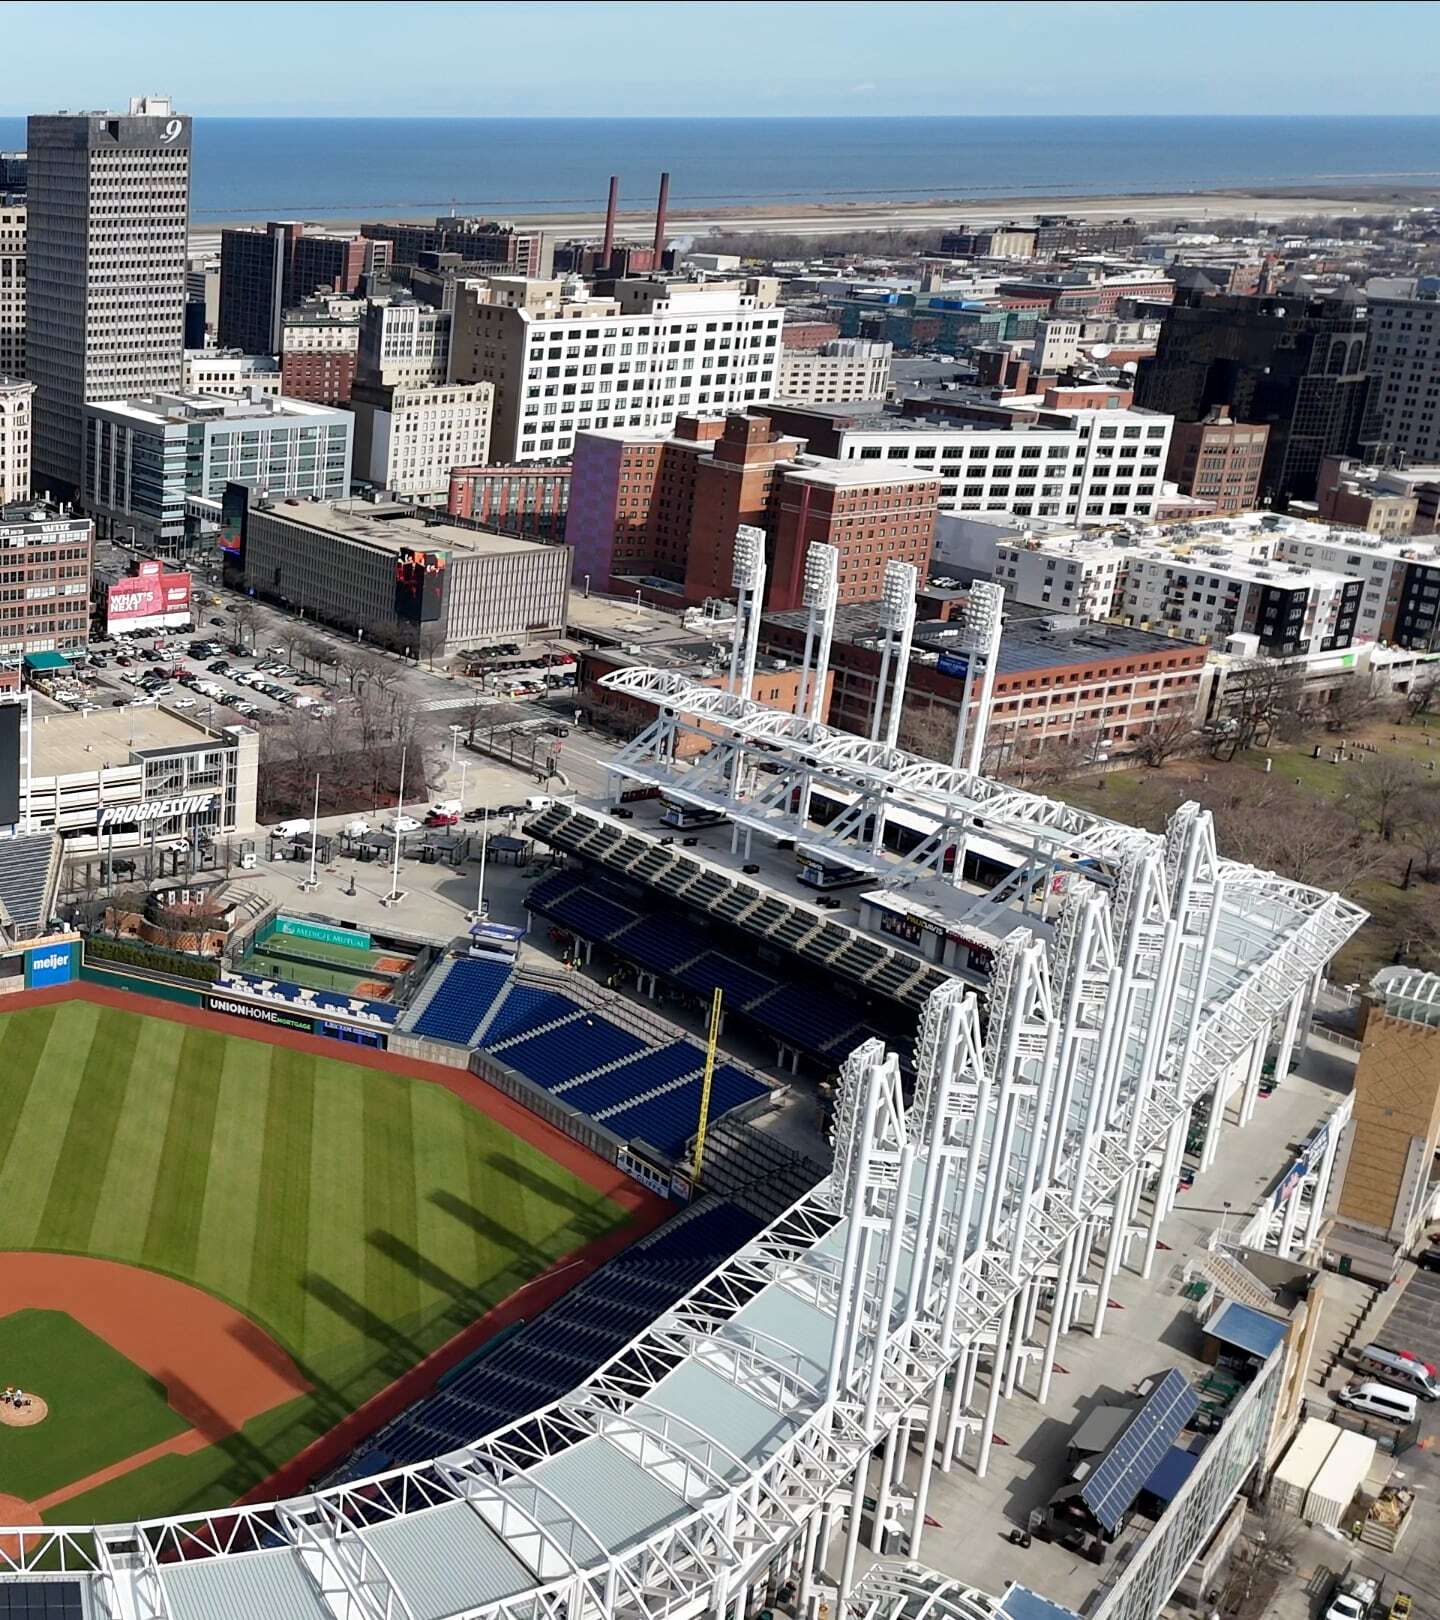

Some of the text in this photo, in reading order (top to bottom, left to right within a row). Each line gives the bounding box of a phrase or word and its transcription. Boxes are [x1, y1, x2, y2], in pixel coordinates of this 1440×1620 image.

[164, 119, 183, 144] 9
[111, 591, 154, 605] WHAT'S
[111, 601, 138, 612] NEXT
[100, 794, 215, 826] PROGRESSIVE
[33, 953, 69, 970] meijer
